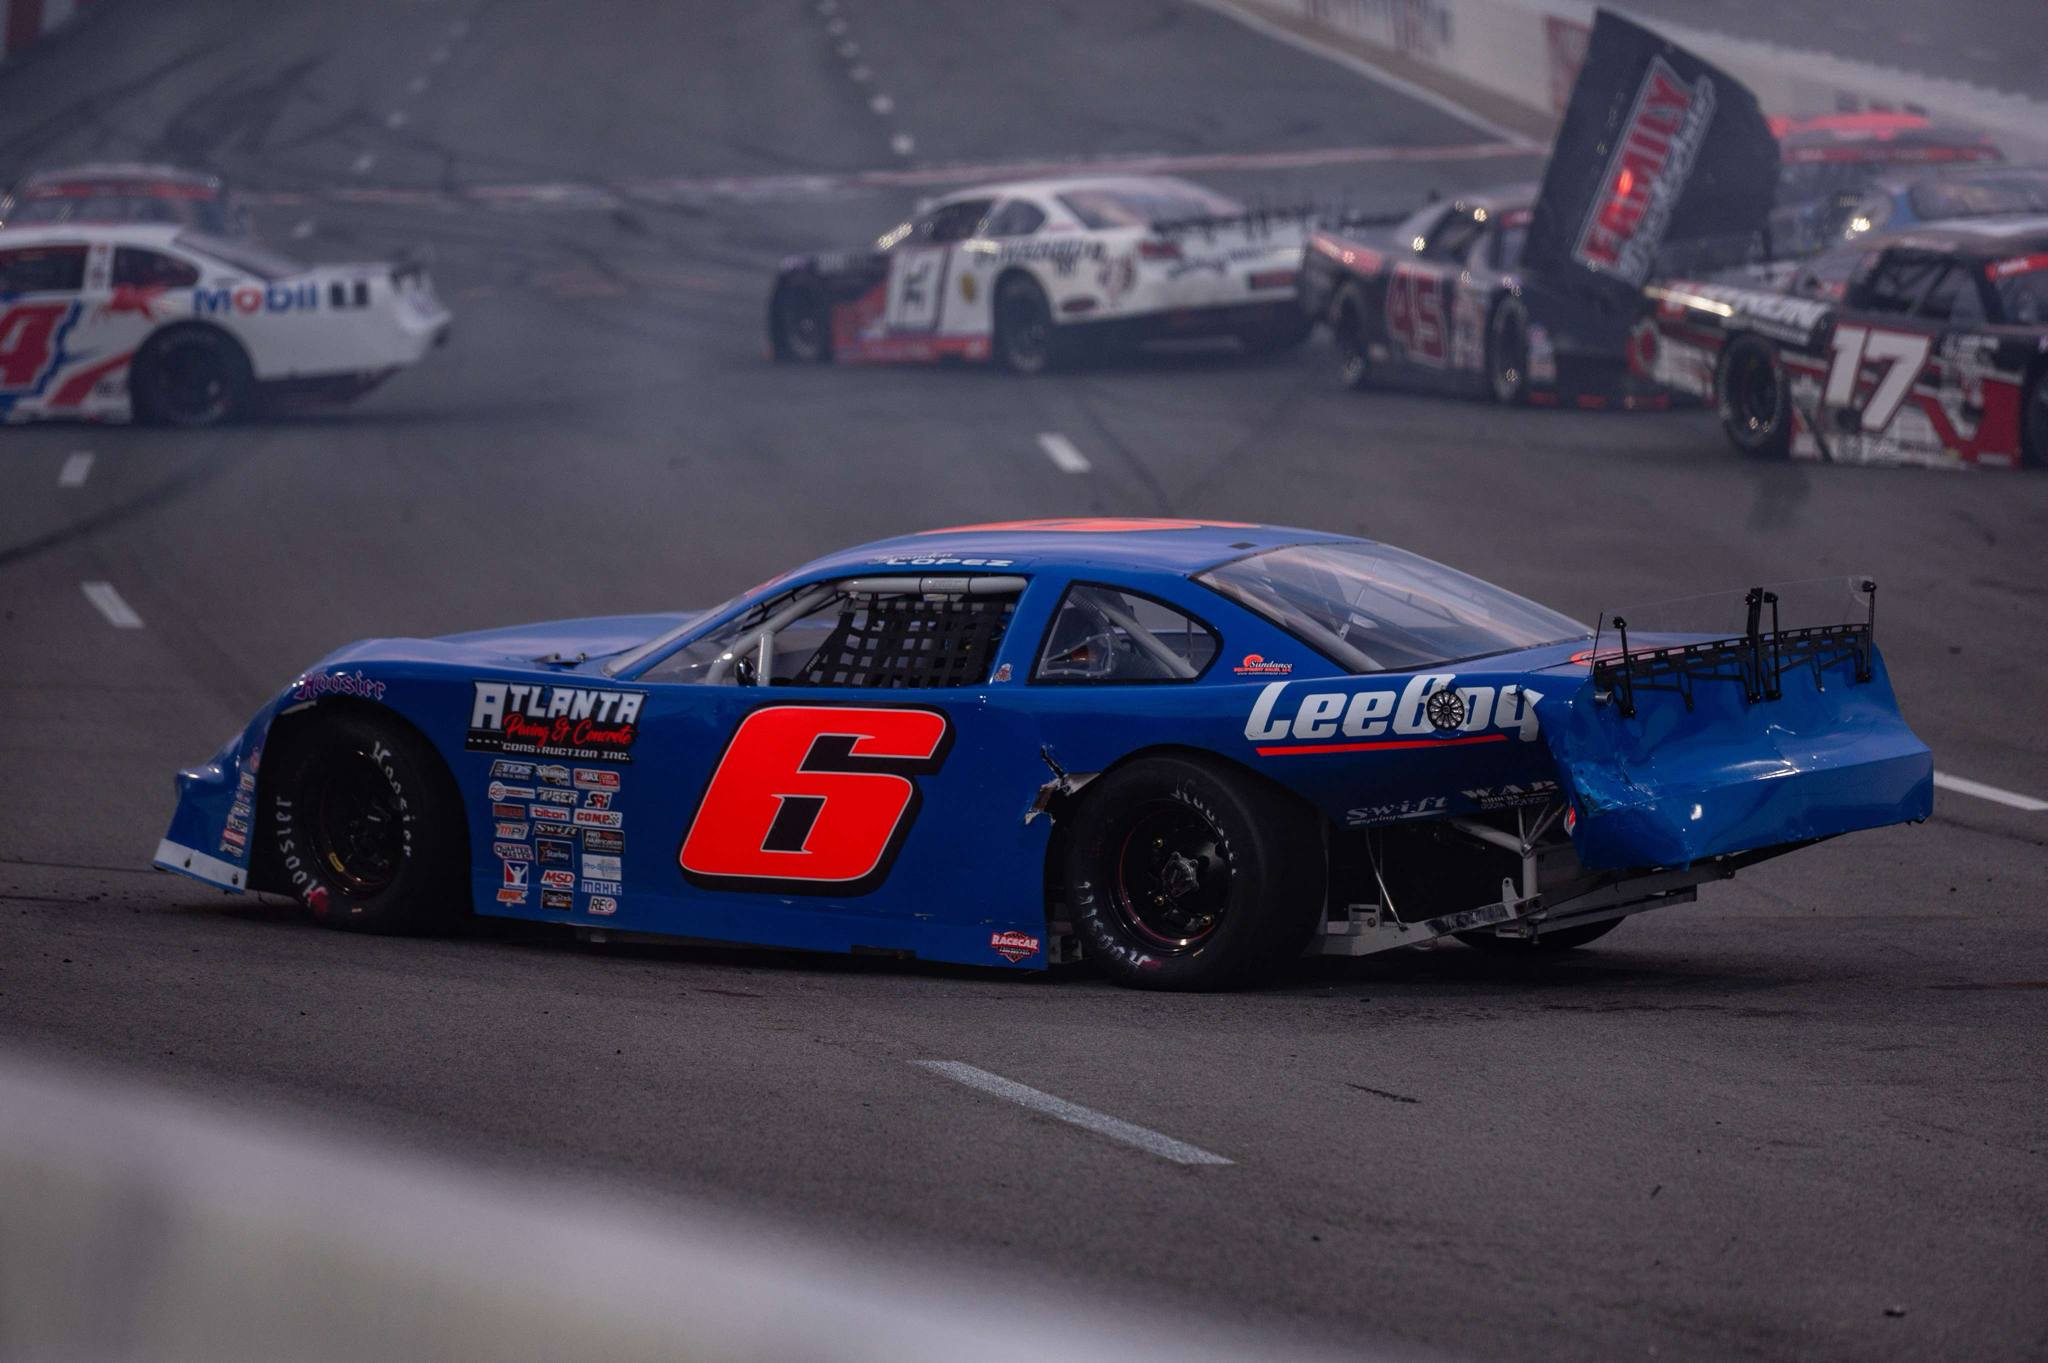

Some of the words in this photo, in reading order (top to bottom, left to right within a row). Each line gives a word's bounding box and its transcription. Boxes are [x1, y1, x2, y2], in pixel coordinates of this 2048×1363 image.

[1583, 71, 1692, 264] FAMILY
[193, 284, 318, 315] Mobil
[1387, 260, 1448, 369] 45
[1824, 324, 1932, 433] 17
[886, 558, 1014, 567] LOPEZ
[1250, 660, 1293, 668] Sundance
[294, 670, 387, 700] Hoosier
[471, 681, 645, 729] ATLANTA
[504, 713, 549, 746] Paving
[552, 716, 572, 743] &
[573, 719, 635, 745] Concrete
[502, 742, 598, 759] CONSTRUCTION
[679, 705, 948, 883] 6
[534, 807, 568, 820] tilton
[576, 811, 610, 824] COMP
[535, 823, 579, 837] Swift
[544, 871, 573, 883] MSD
[582, 880, 622, 896] MAHLE
[991, 933, 1040, 951] RACECAR
